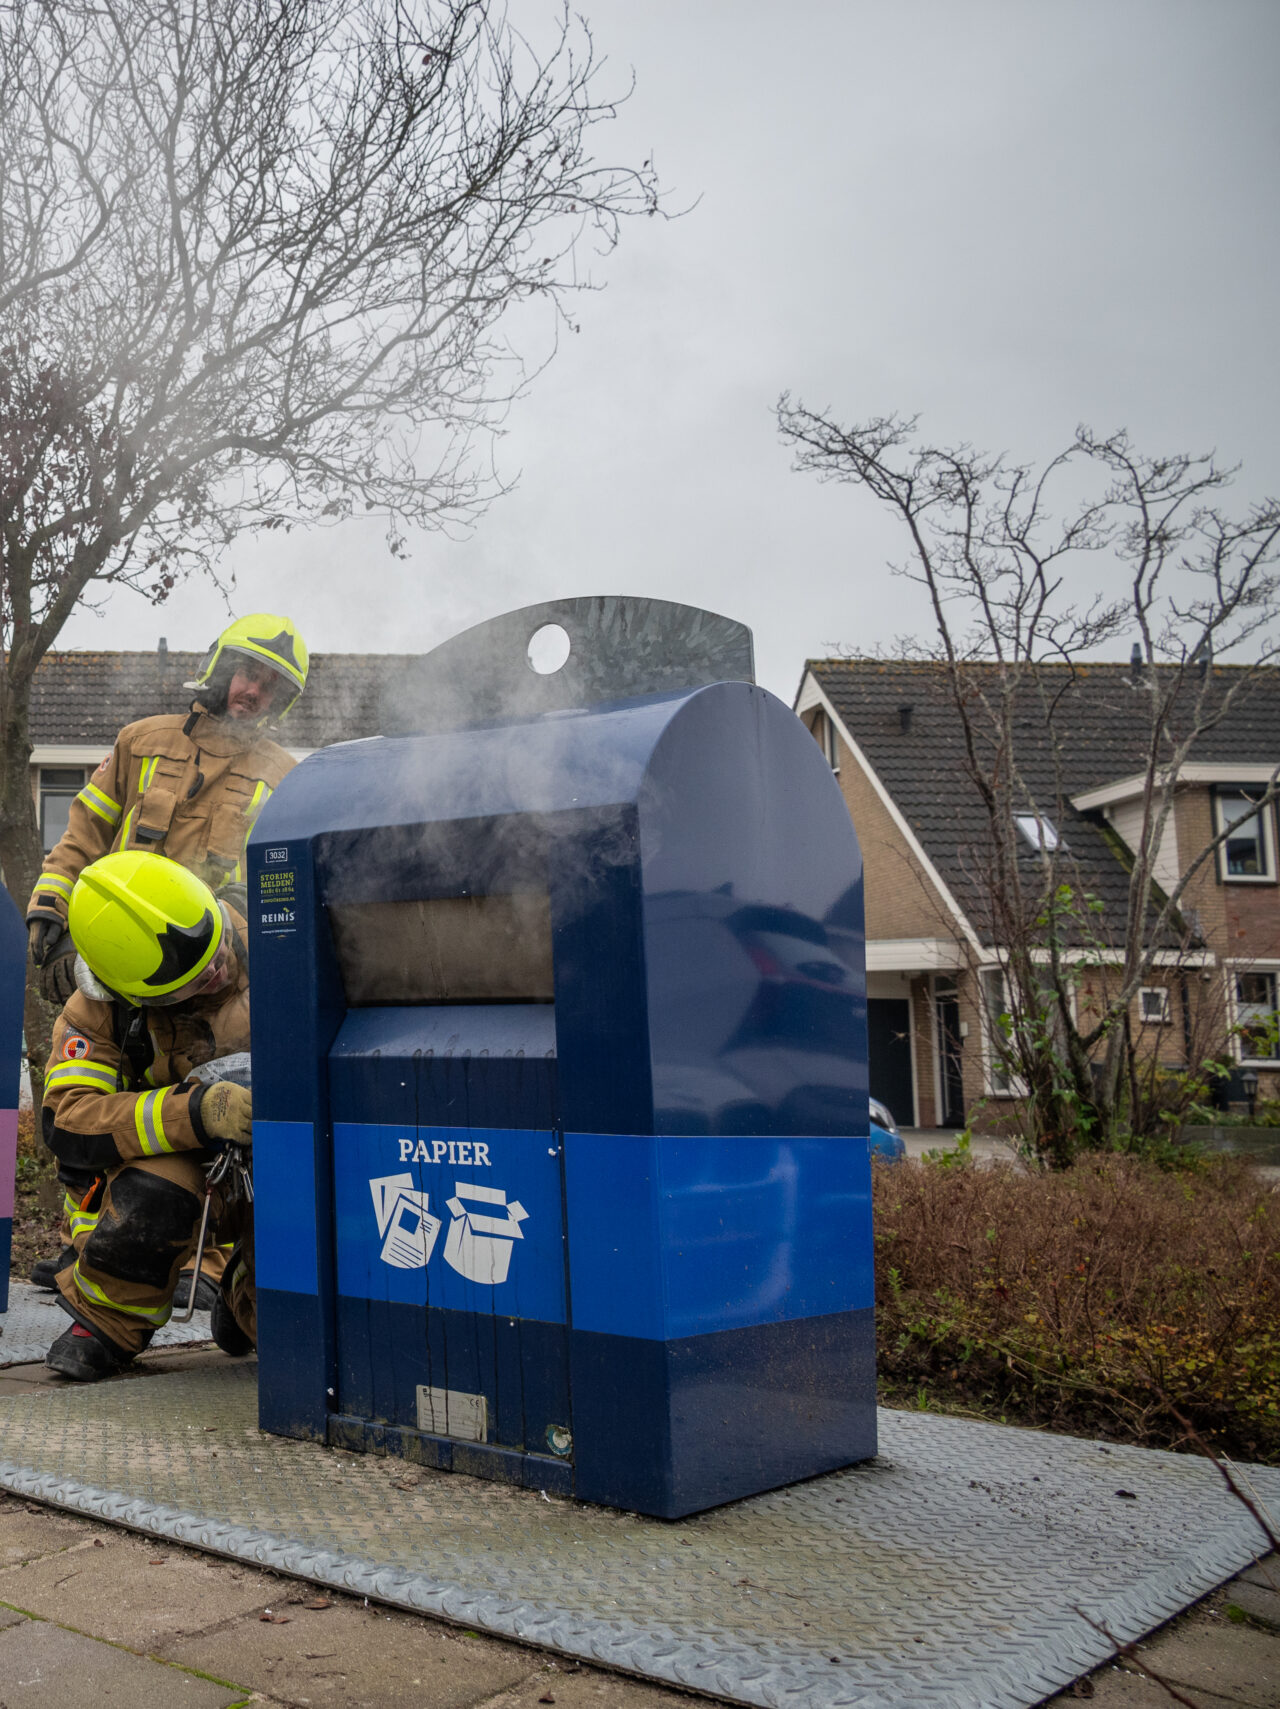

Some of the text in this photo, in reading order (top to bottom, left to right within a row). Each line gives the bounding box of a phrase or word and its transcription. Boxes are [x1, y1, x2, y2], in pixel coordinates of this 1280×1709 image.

[269, 851, 285, 860] 3032
[260, 872, 294, 881] STORING
[260, 879, 294, 888] MELDEN?
[261, 911, 295, 923] REINIS
[398, 1138, 492, 1167] PAPIER
